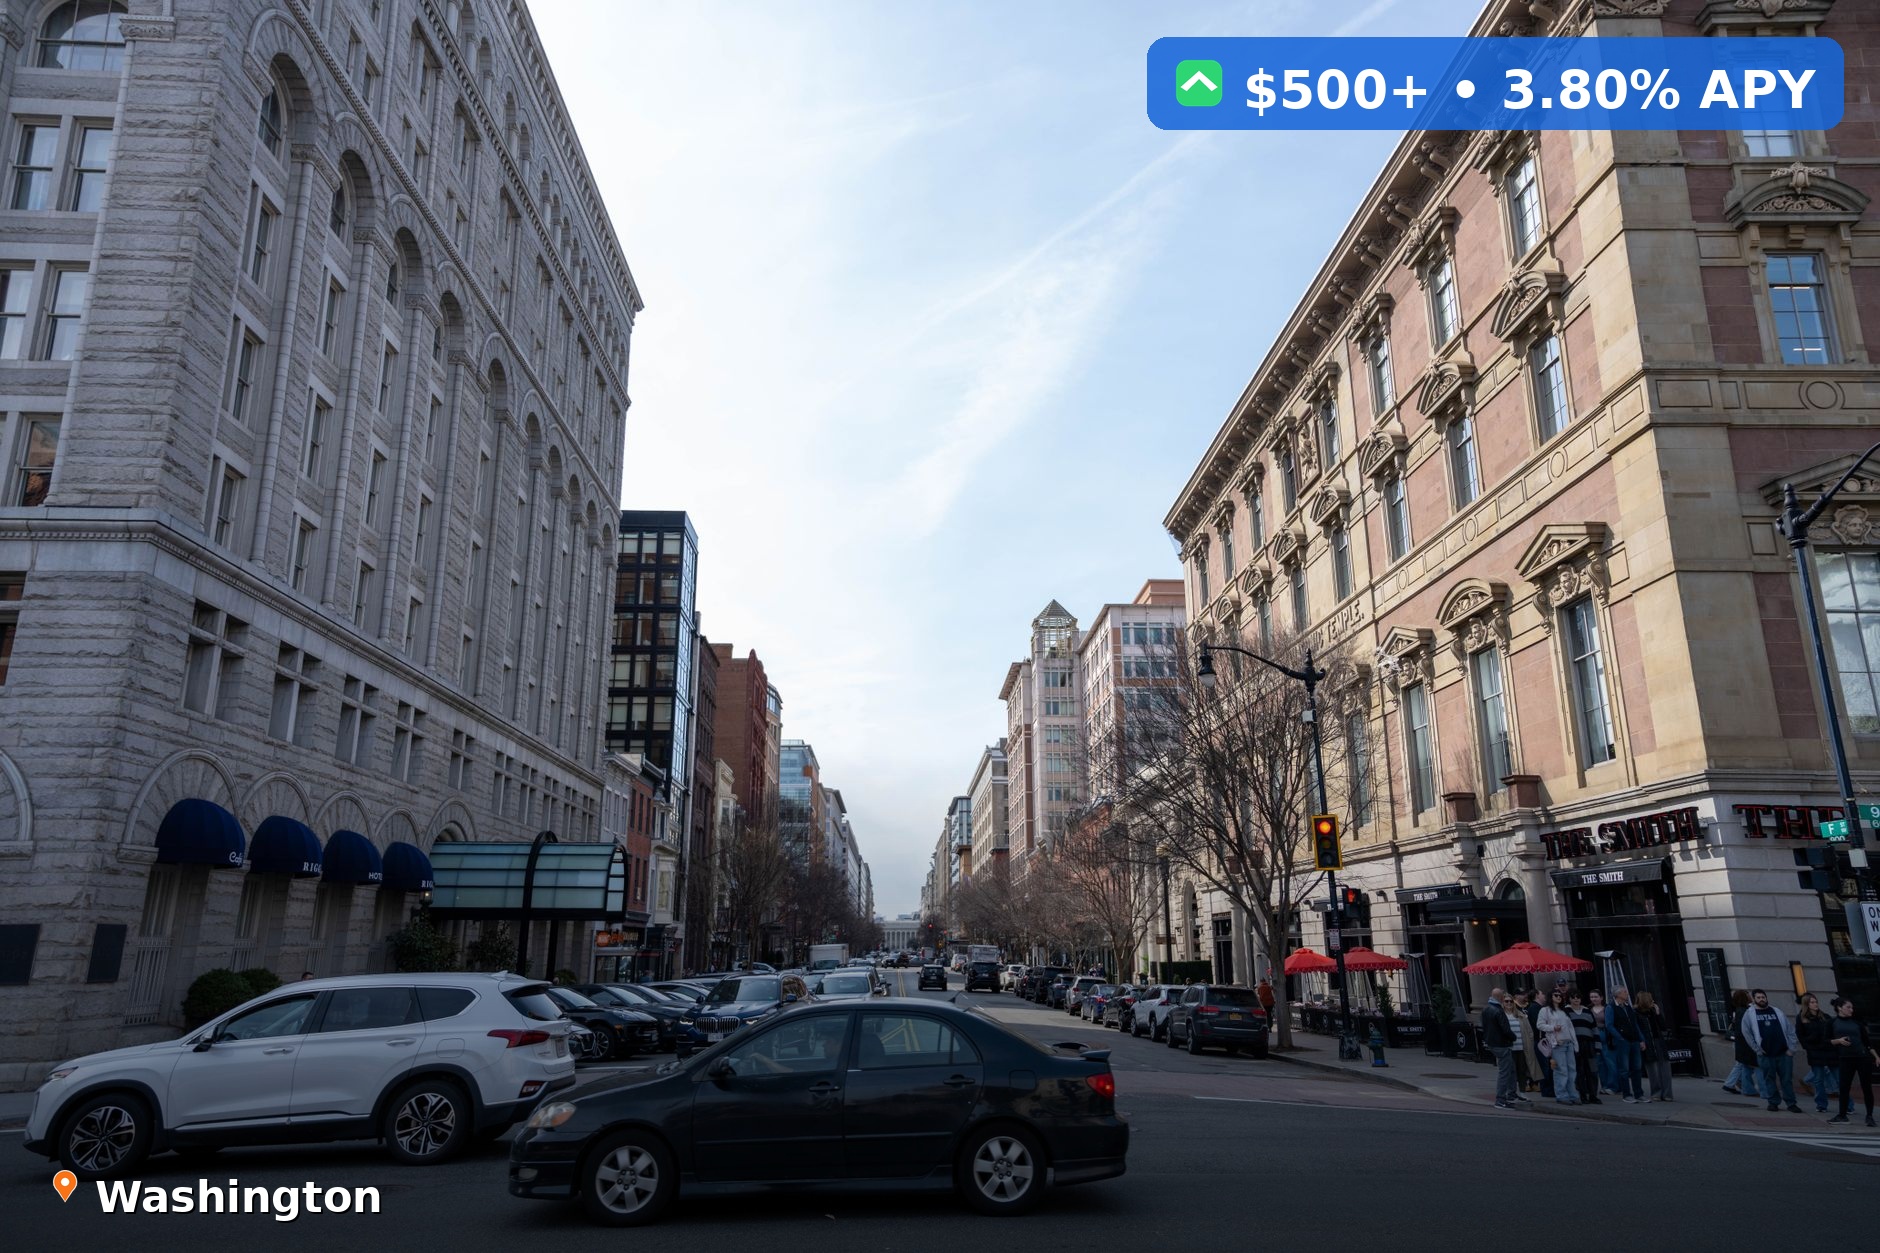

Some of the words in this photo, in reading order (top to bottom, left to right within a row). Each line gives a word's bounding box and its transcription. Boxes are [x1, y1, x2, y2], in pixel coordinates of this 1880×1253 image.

[1539, 826, 1596, 860] THE
[1598, 806, 1704, 854] SMITH
[1827, 823, 1835, 835] F
[1582, 873, 1598, 884] THE
[1599, 871, 1624, 883] SMITH
[1413, 892, 1424, 901] THE
